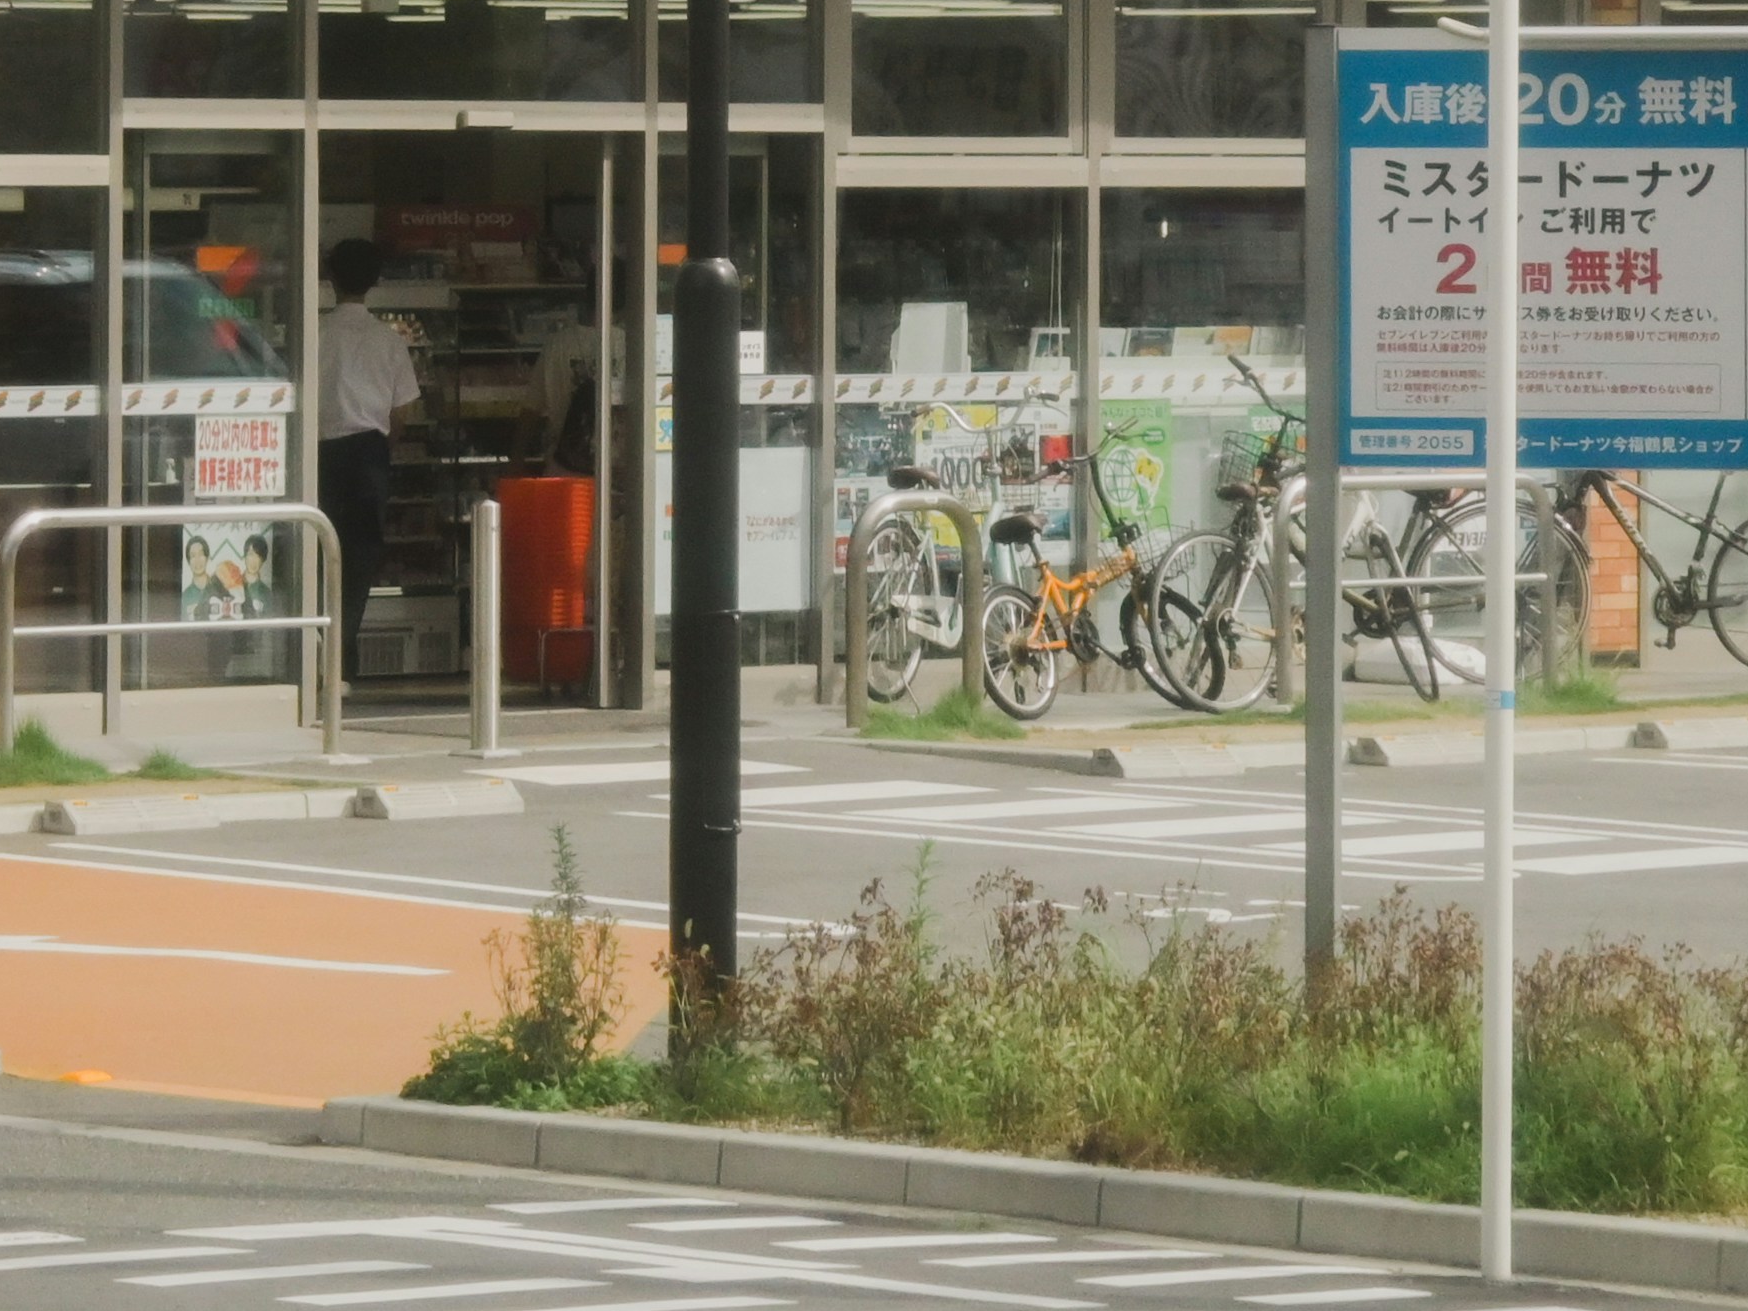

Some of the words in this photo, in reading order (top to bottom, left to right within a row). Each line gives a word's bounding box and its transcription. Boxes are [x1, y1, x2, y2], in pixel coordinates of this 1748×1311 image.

[1360, 82, 1487, 125] 入庫後
[1638, 76, 1736, 125] 無料
[475, 212, 514, 227] pop
[1565, 247, 1662, 294] 無料
[1377, 305, 1718, 322] お会計の際にサス券をお受け取りください。
[1358, 435, 1412, 449] 管理番号
[1418, 436, 1464, 450] 2055
